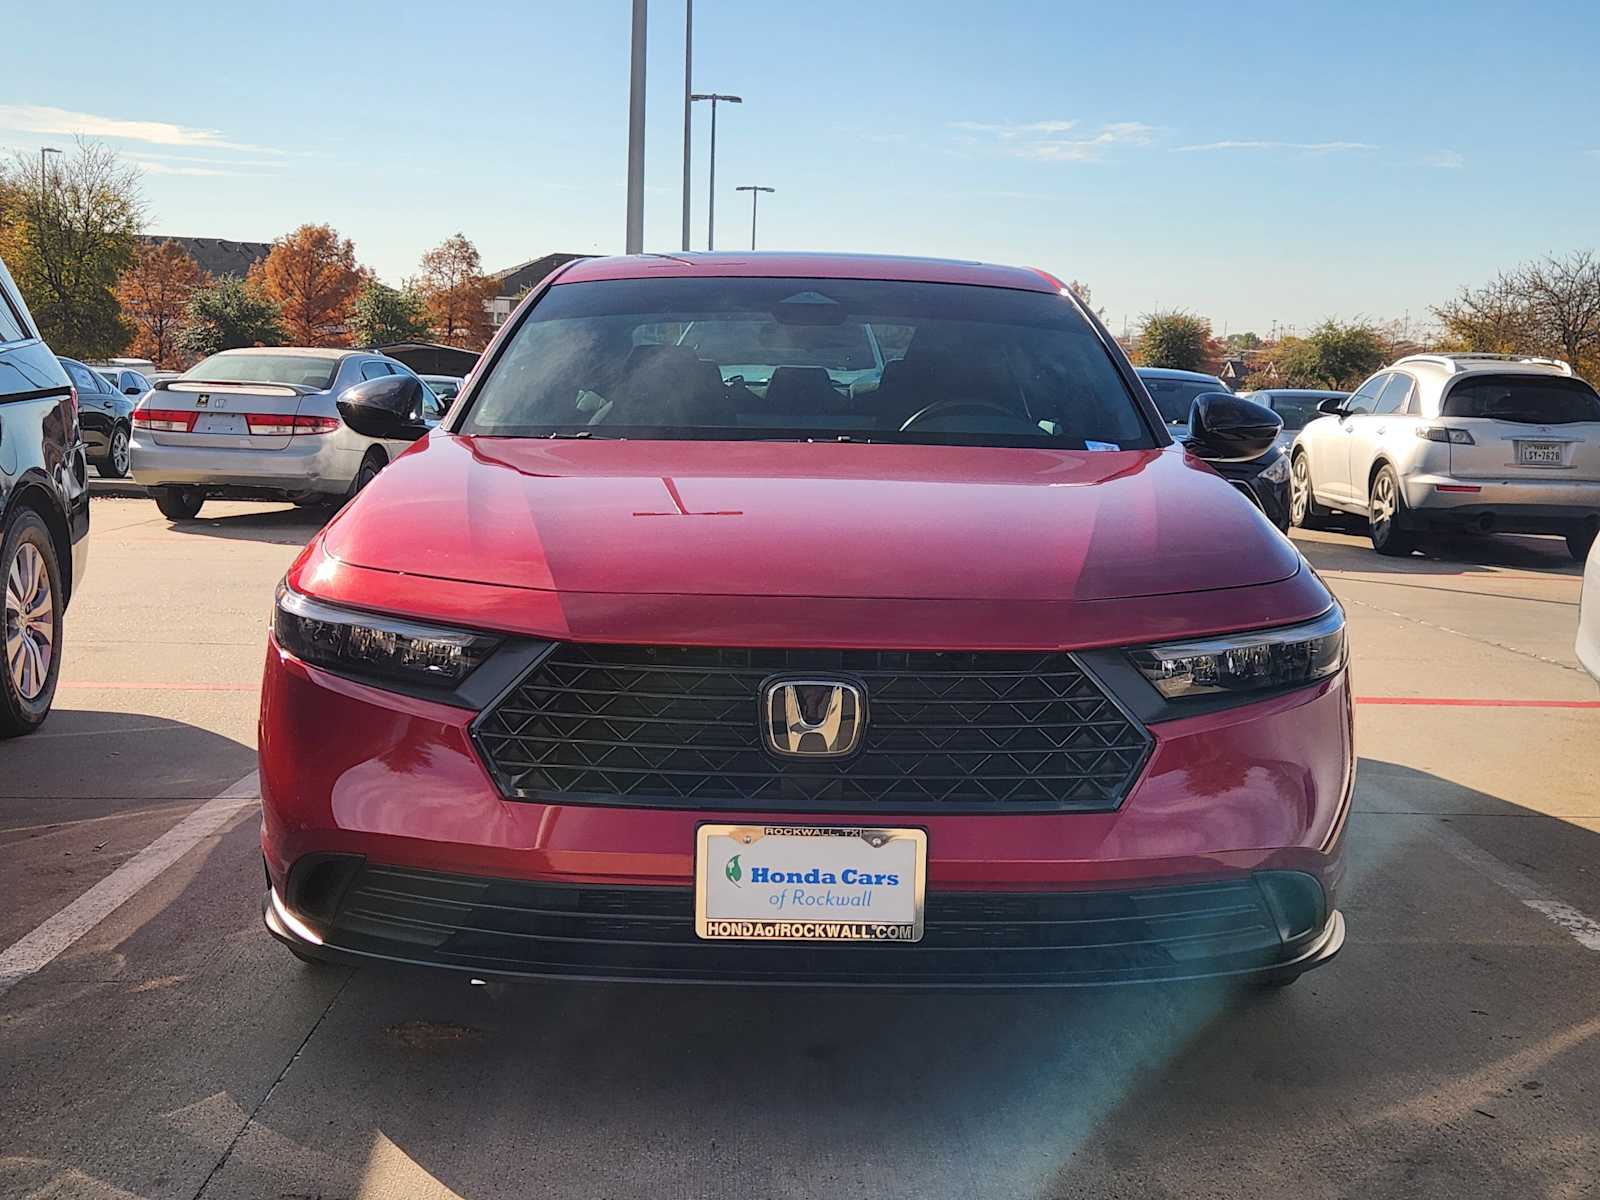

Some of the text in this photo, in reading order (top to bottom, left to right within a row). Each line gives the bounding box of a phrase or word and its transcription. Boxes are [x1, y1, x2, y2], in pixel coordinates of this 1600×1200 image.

[751, 867, 900, 886] Honda Cars
[769, 888, 872, 910] of Rockwall
[707, 922, 912, 939] HONDAofROCKWALL.COM
